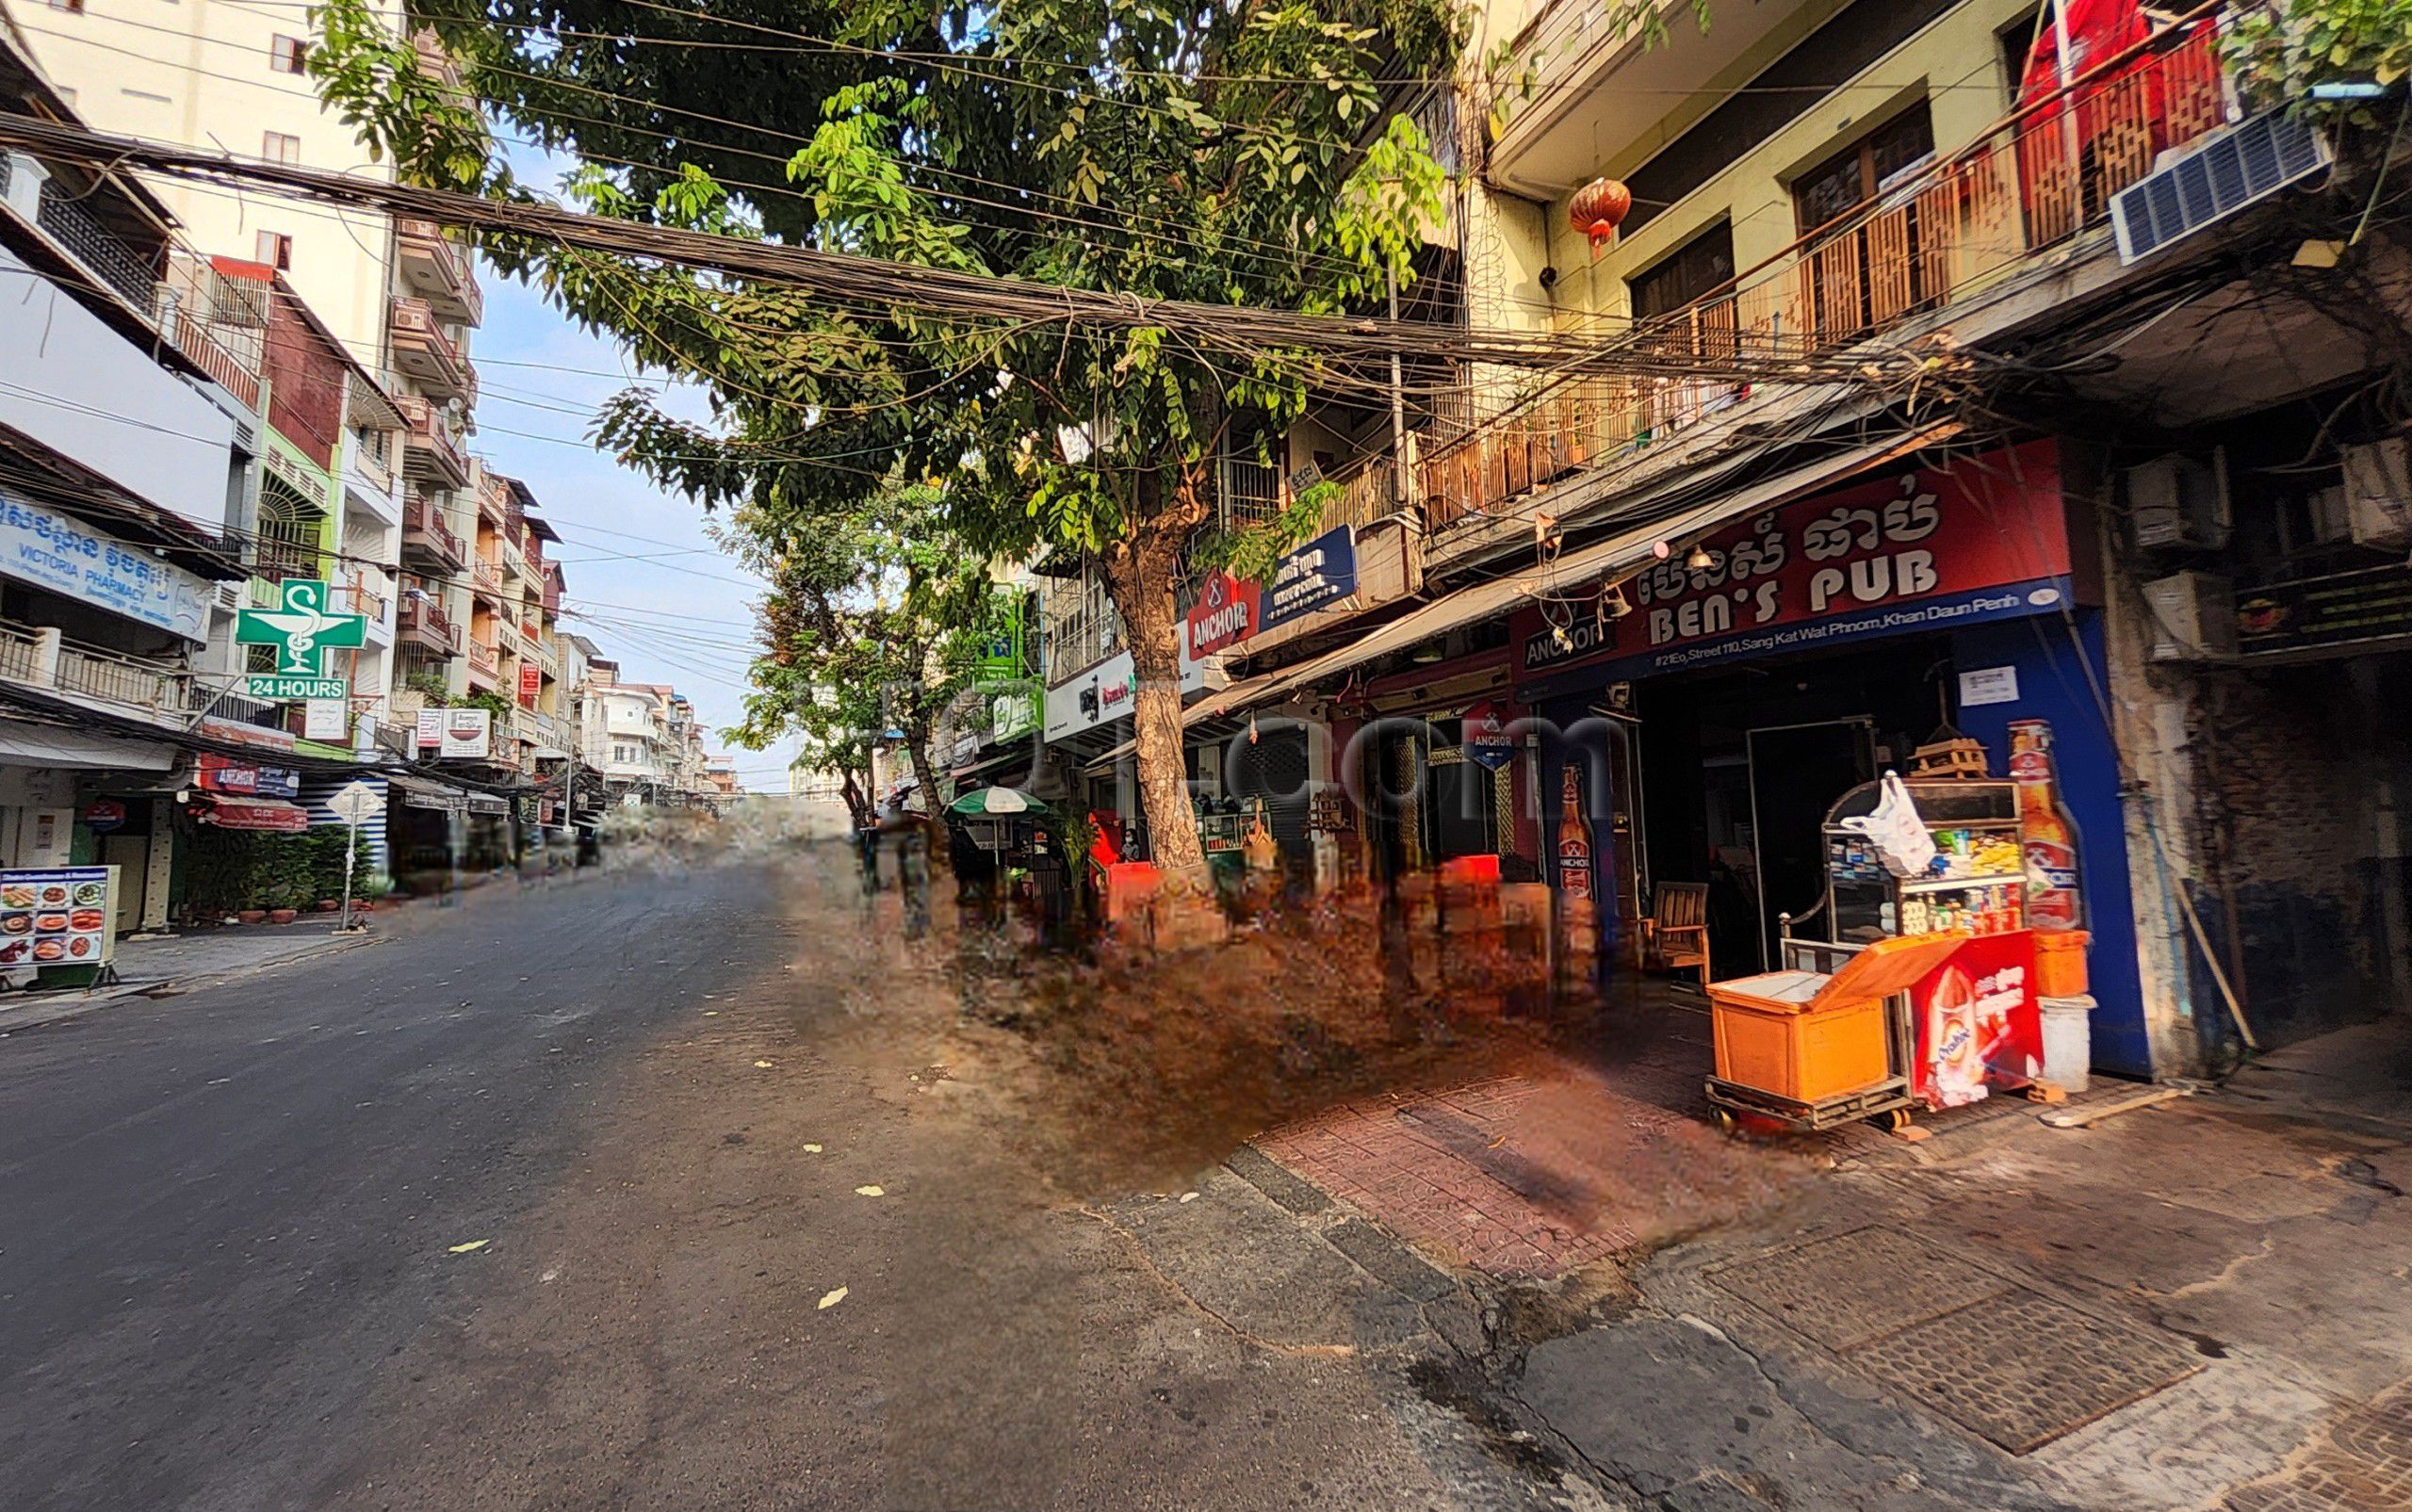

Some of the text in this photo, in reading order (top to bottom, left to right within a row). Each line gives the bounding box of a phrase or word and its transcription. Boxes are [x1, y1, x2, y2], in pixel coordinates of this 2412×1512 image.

[18, 543, 79, 579] VICTORIA
[85, 569, 148, 603] PHARMACY
[1650, 550, 1937, 646] BEN'S PUB
[1194, 601, 1248, 648] ANCHOR
[1799, 626, 1827, 641] Wat
[253, 679, 343, 698] 24 HOURS
[1475, 735, 1512, 747] ANCHOR
[1559, 856, 1589, 869] ANCHOR
